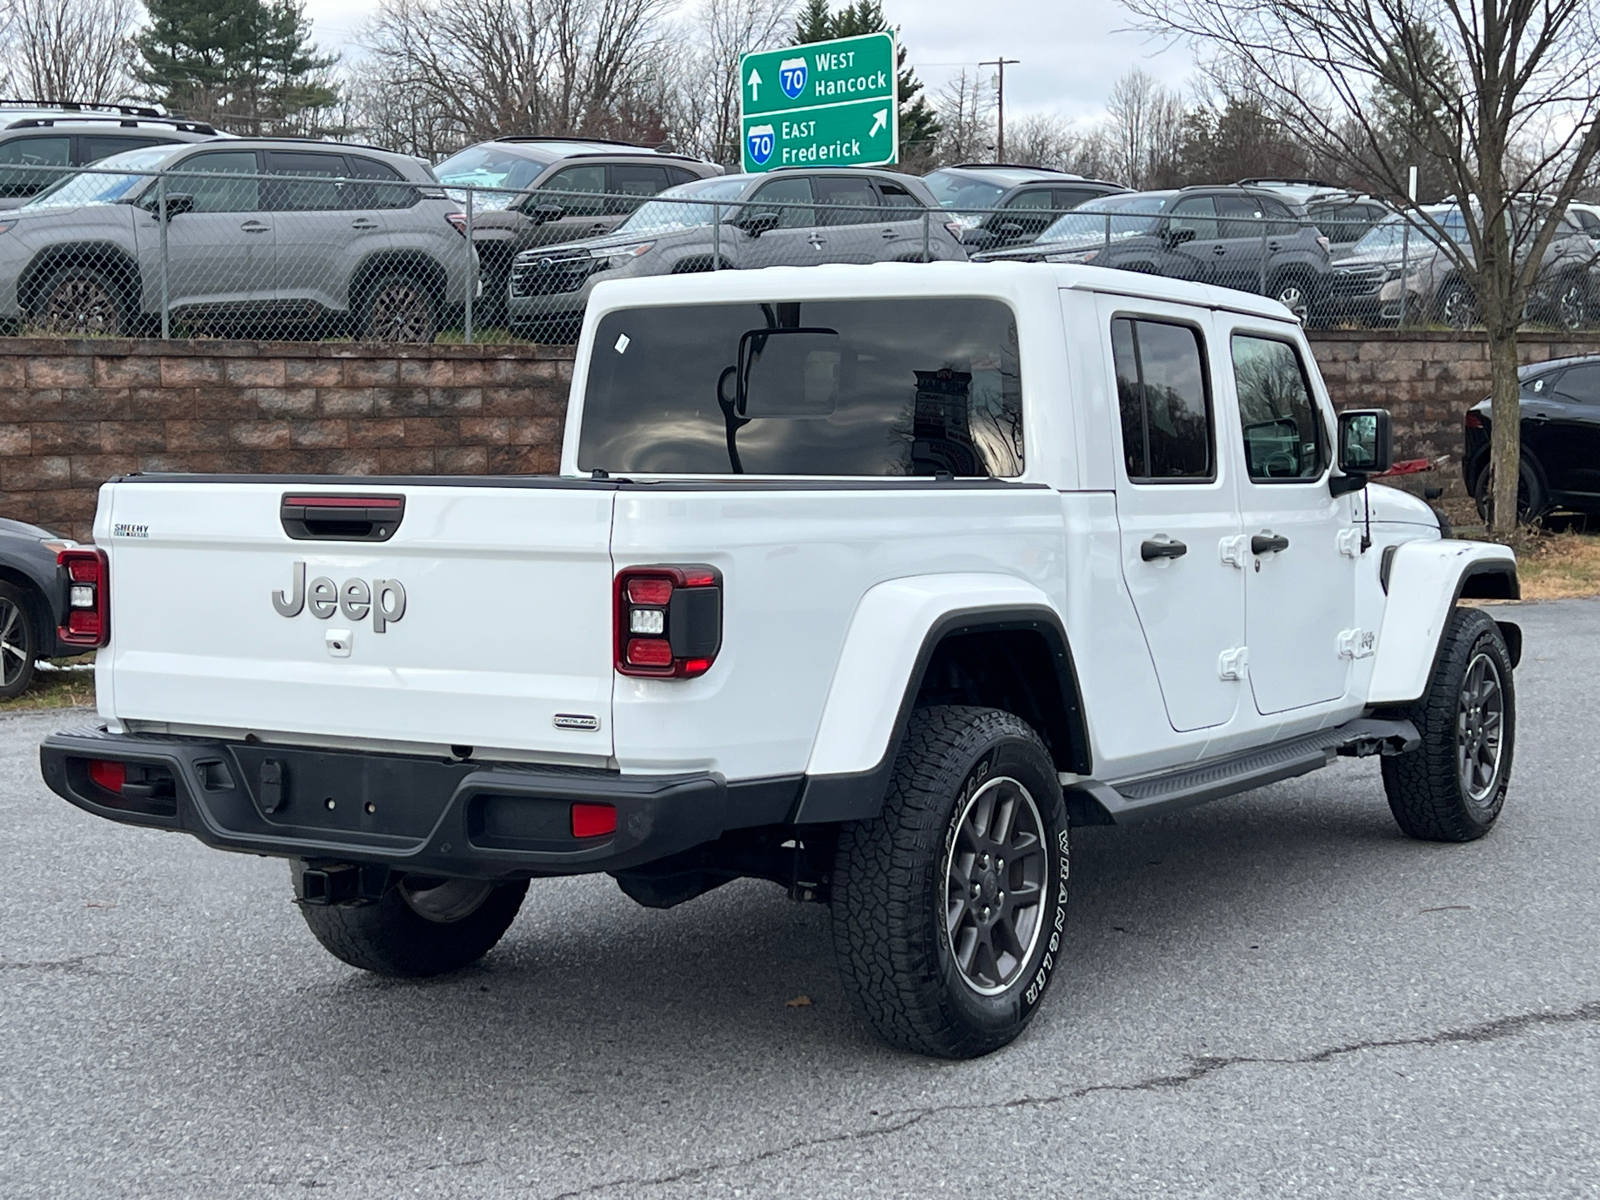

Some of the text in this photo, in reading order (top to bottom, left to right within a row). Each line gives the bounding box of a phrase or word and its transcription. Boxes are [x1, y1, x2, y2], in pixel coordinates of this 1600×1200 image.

[784, 52, 855, 90] 70 WEST
[815, 70, 887, 97] Hancock
[751, 121, 816, 156] 70 EAST
[782, 139, 861, 164] Frederick
[114, 523, 149, 533] SHEEHY
[271, 561, 407, 633] Jeep
[553, 717, 597, 725] OVERLAND
[1026, 829, 1070, 1005] WRANGLER
